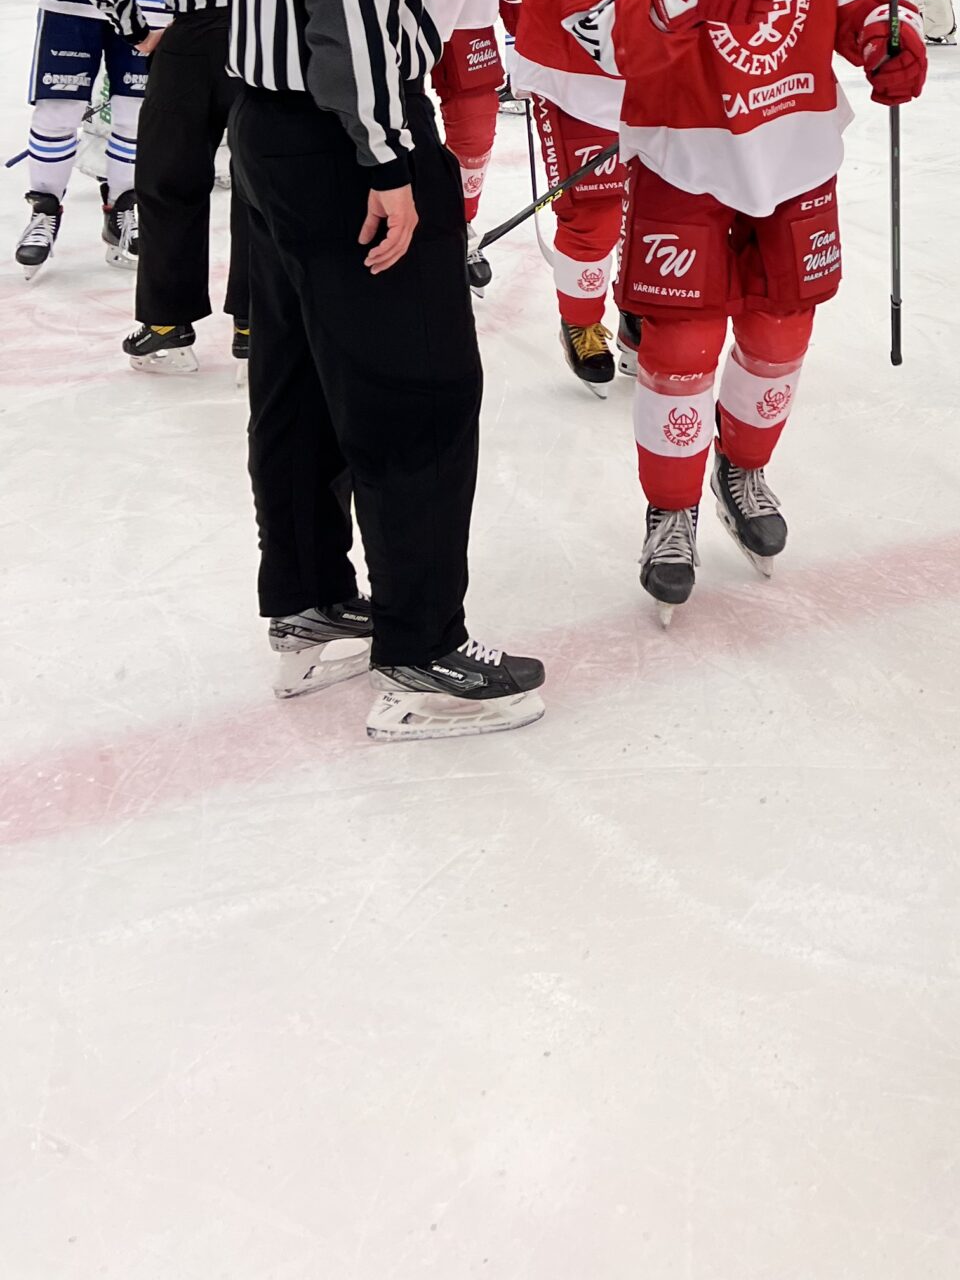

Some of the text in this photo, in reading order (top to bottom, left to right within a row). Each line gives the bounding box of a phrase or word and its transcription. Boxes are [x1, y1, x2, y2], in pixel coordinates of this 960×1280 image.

[469, 38, 491, 51] Team
[752, 77, 810, 105] KVANTUM
[801, 192, 833, 211] CCM
[809, 230, 836, 250] Team
[642, 234, 697, 277] TW
[633, 282, 660, 295] VÄRME
[661, 287, 668, 296] &
[669, 372, 704, 382] CCM
